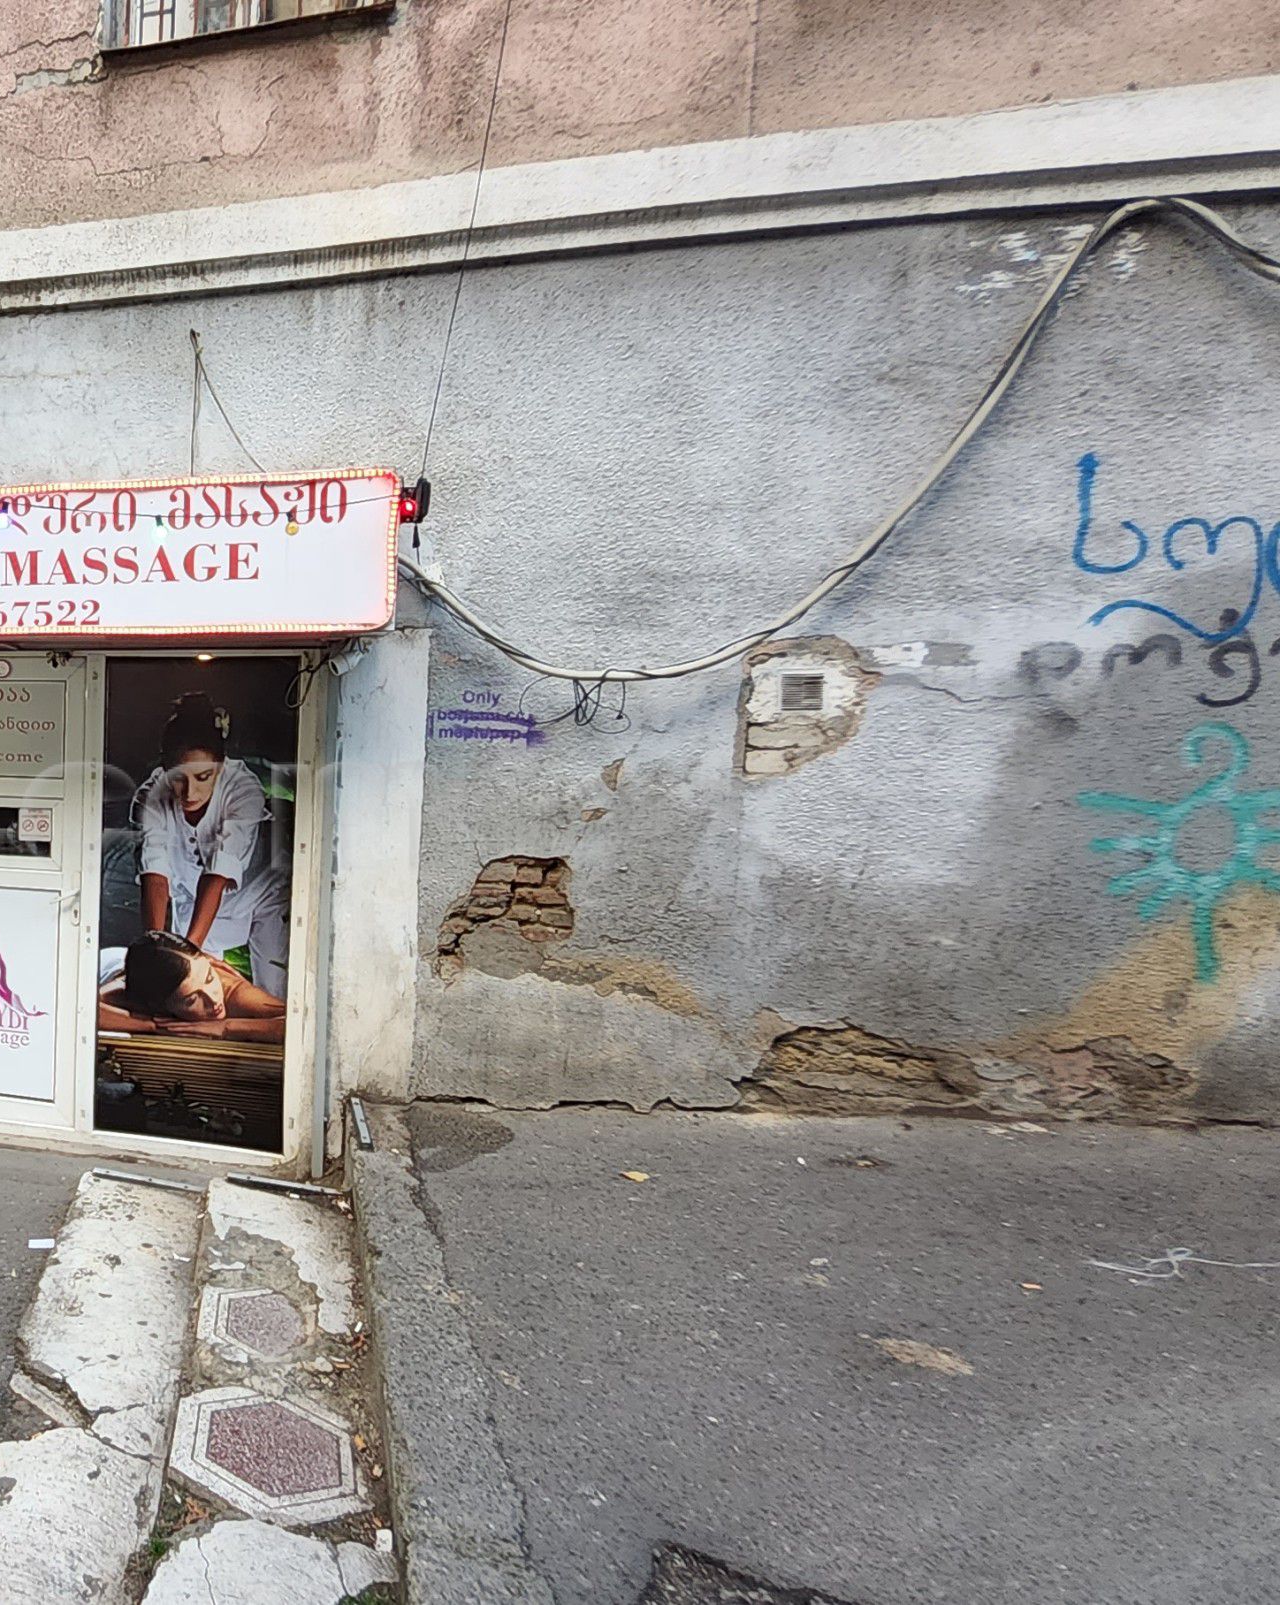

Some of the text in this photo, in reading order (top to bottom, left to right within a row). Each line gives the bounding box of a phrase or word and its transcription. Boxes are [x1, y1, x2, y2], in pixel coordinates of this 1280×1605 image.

[167, 479, 348, 530] მასაჟი
[1, 543, 260, 586] MASSAGE
[462, 690, 501, 708] Only
